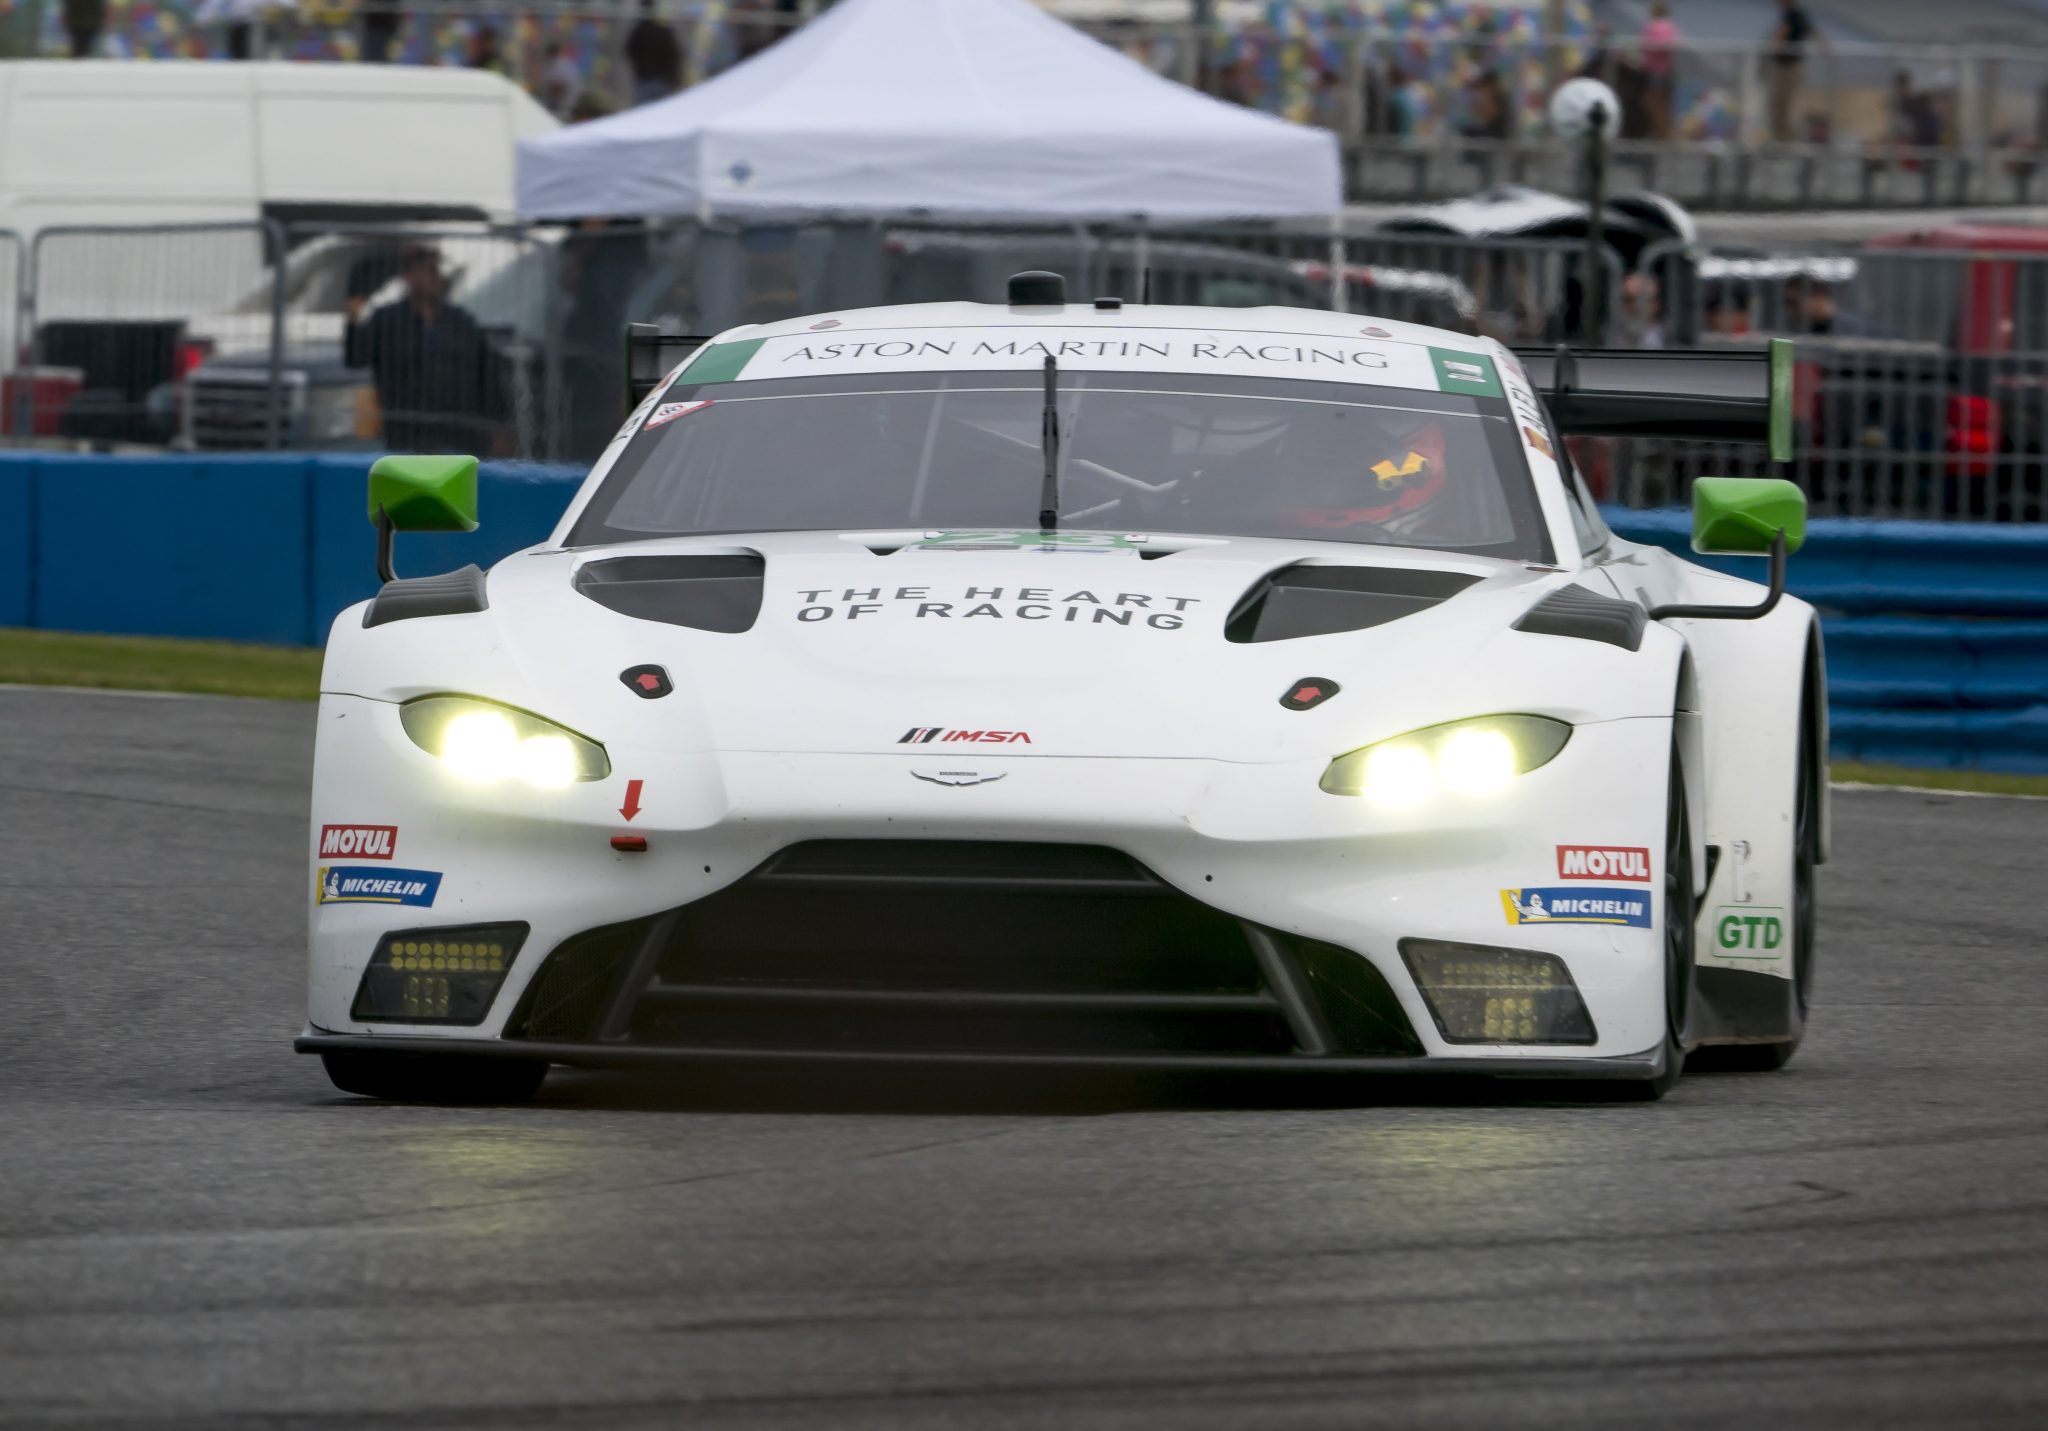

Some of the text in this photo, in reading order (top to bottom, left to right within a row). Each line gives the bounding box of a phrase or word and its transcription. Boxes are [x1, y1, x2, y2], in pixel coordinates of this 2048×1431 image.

[782, 340, 1388, 369] ASTON MARTIN RACING
[797, 586, 1201, 612] THE HEART
[796, 602, 1186, 631] OF RACING
[941, 730, 1032, 744] IMSA
[321, 828, 392, 855] MOTUL
[1562, 849, 1649, 877] MOTUL
[341, 878, 428, 896] MICHELIN
[1551, 898, 1643, 917] MICHELIN
[1718, 915, 1784, 950] GTD
